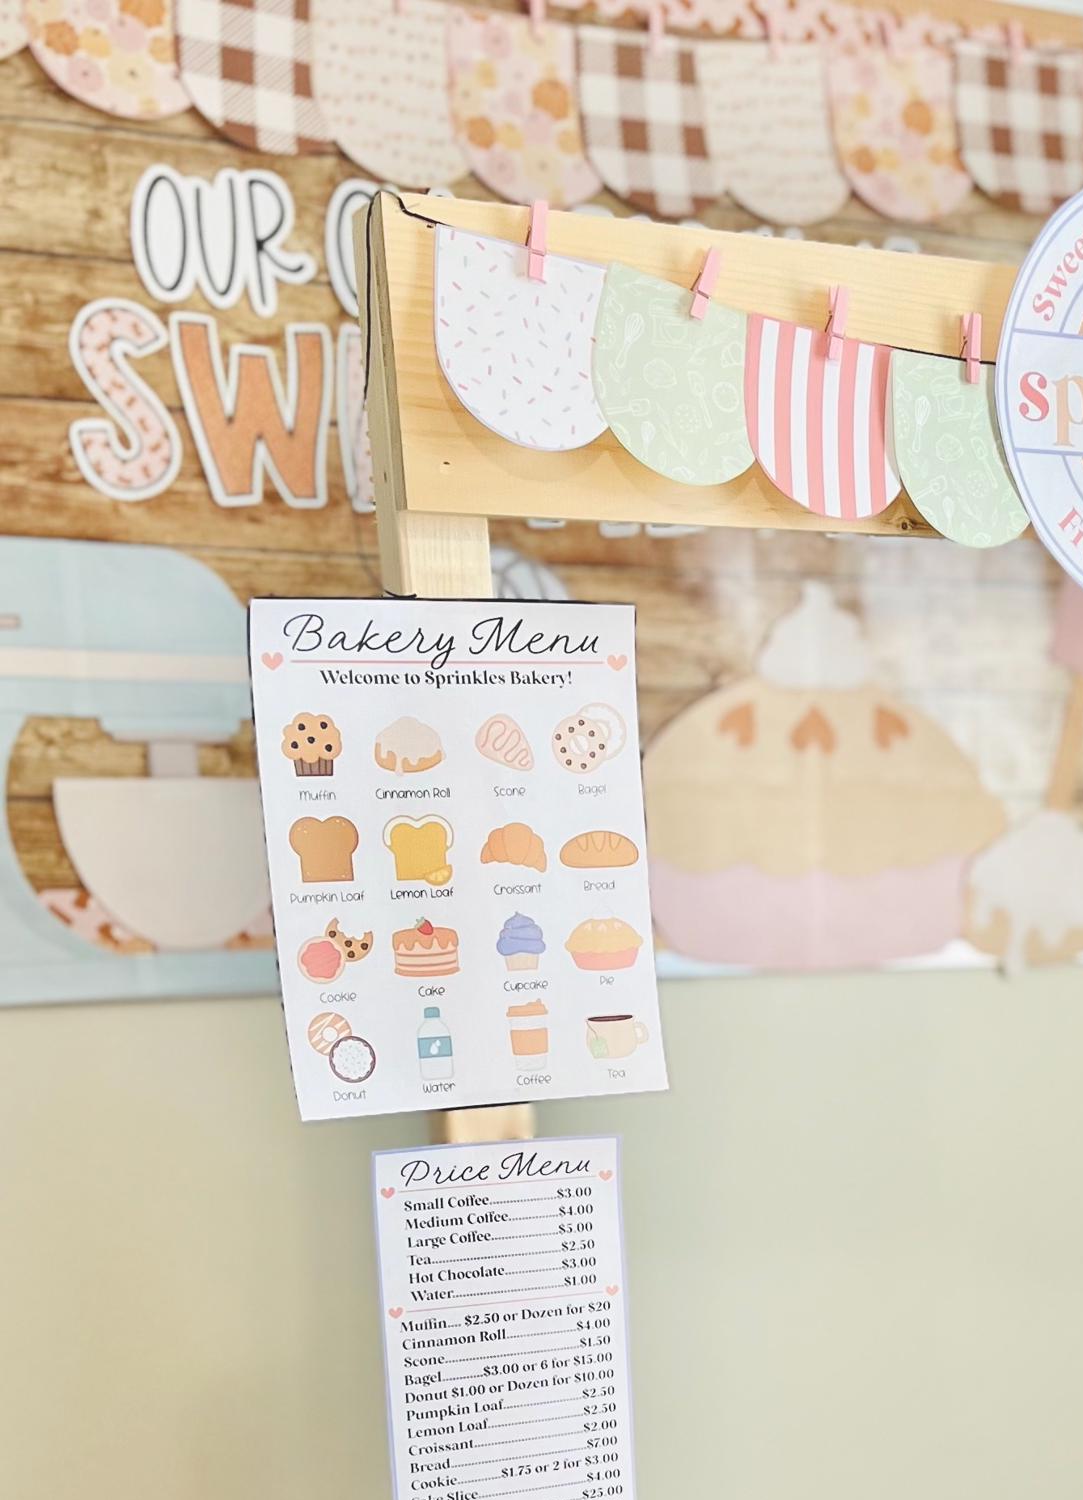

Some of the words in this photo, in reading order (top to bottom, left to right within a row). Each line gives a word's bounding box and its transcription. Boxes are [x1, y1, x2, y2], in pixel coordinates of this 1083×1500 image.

[136, 168, 312, 316] OUR
[69, 297, 378, 513] SW
[282, 613, 456, 670] Bakery
[468, 616, 600, 656] Menu
[319, 669, 400, 686] Welcome
[403, 672, 420, 686] to
[424, 670, 506, 689] Sprinkles
[509, 671, 572, 689] Bakery!
[299, 789, 337, 801] Muffin
[375, 786, 430, 800] Cinnamon
[432, 785, 451, 799] Roll
[493, 784, 526, 798] Scone
[577, 783, 607, 797] Bagel
[493, 883, 542, 896] Croissant
[583, 879, 616, 892] Bread
[289, 891, 338, 904] Pumpkin
[340, 890, 365, 903] Loaf
[390, 888, 428, 901] Lemon
[430, 886, 454, 899] Loaf
[503, 978, 549, 992] Cupcake
[599, 974, 615, 987] Pie
[319, 990, 358, 1003] Cookie
[418, 985, 446, 998] Cake
[516, 1073, 552, 1087] Coffee
[608, 1068, 626, 1079] Tea
[422, 1081, 456, 1094] Water
[333, 1088, 367, 1102] Donut
[400, 1160, 490, 1187] Price
[498, 1152, 591, 1180] Menu
[403, 1198, 444, 1212] Small
[404, 1214, 463, 1231] Medium
[409, 1271, 434, 1285] Hot
[464, 1312, 500, 1327] $2.50
[502, 1310, 518, 1322] or
[521, 1304, 563, 1320] Dozen
[565, 1302, 586, 1316] for
[587, 1300, 611, 1313] $20
[402, 1335, 476, 1351] Cinnamon
[522, 1362, 537, 1373] or
[540, 1359, 548, 1370] 6
[551, 1357, 572, 1369] for
[573, 1351, 613, 1366] $15.00
[404, 1389, 448, 1404] Donut
[451, 1383, 485, 1399] $1.00
[488, 1382, 505, 1394] or
[507, 1378, 549, 1392] Dozen
[552, 1374, 572, 1387] for
[573, 1368, 614, 1383] $10.00
[406, 1404, 471, 1422] Pumpkin
[534, 1462, 550, 1473] or
[552, 1459, 560, 1471] 2
[563, 1458, 582, 1470] for
[584, 1452, 619, 1465] $3.00
